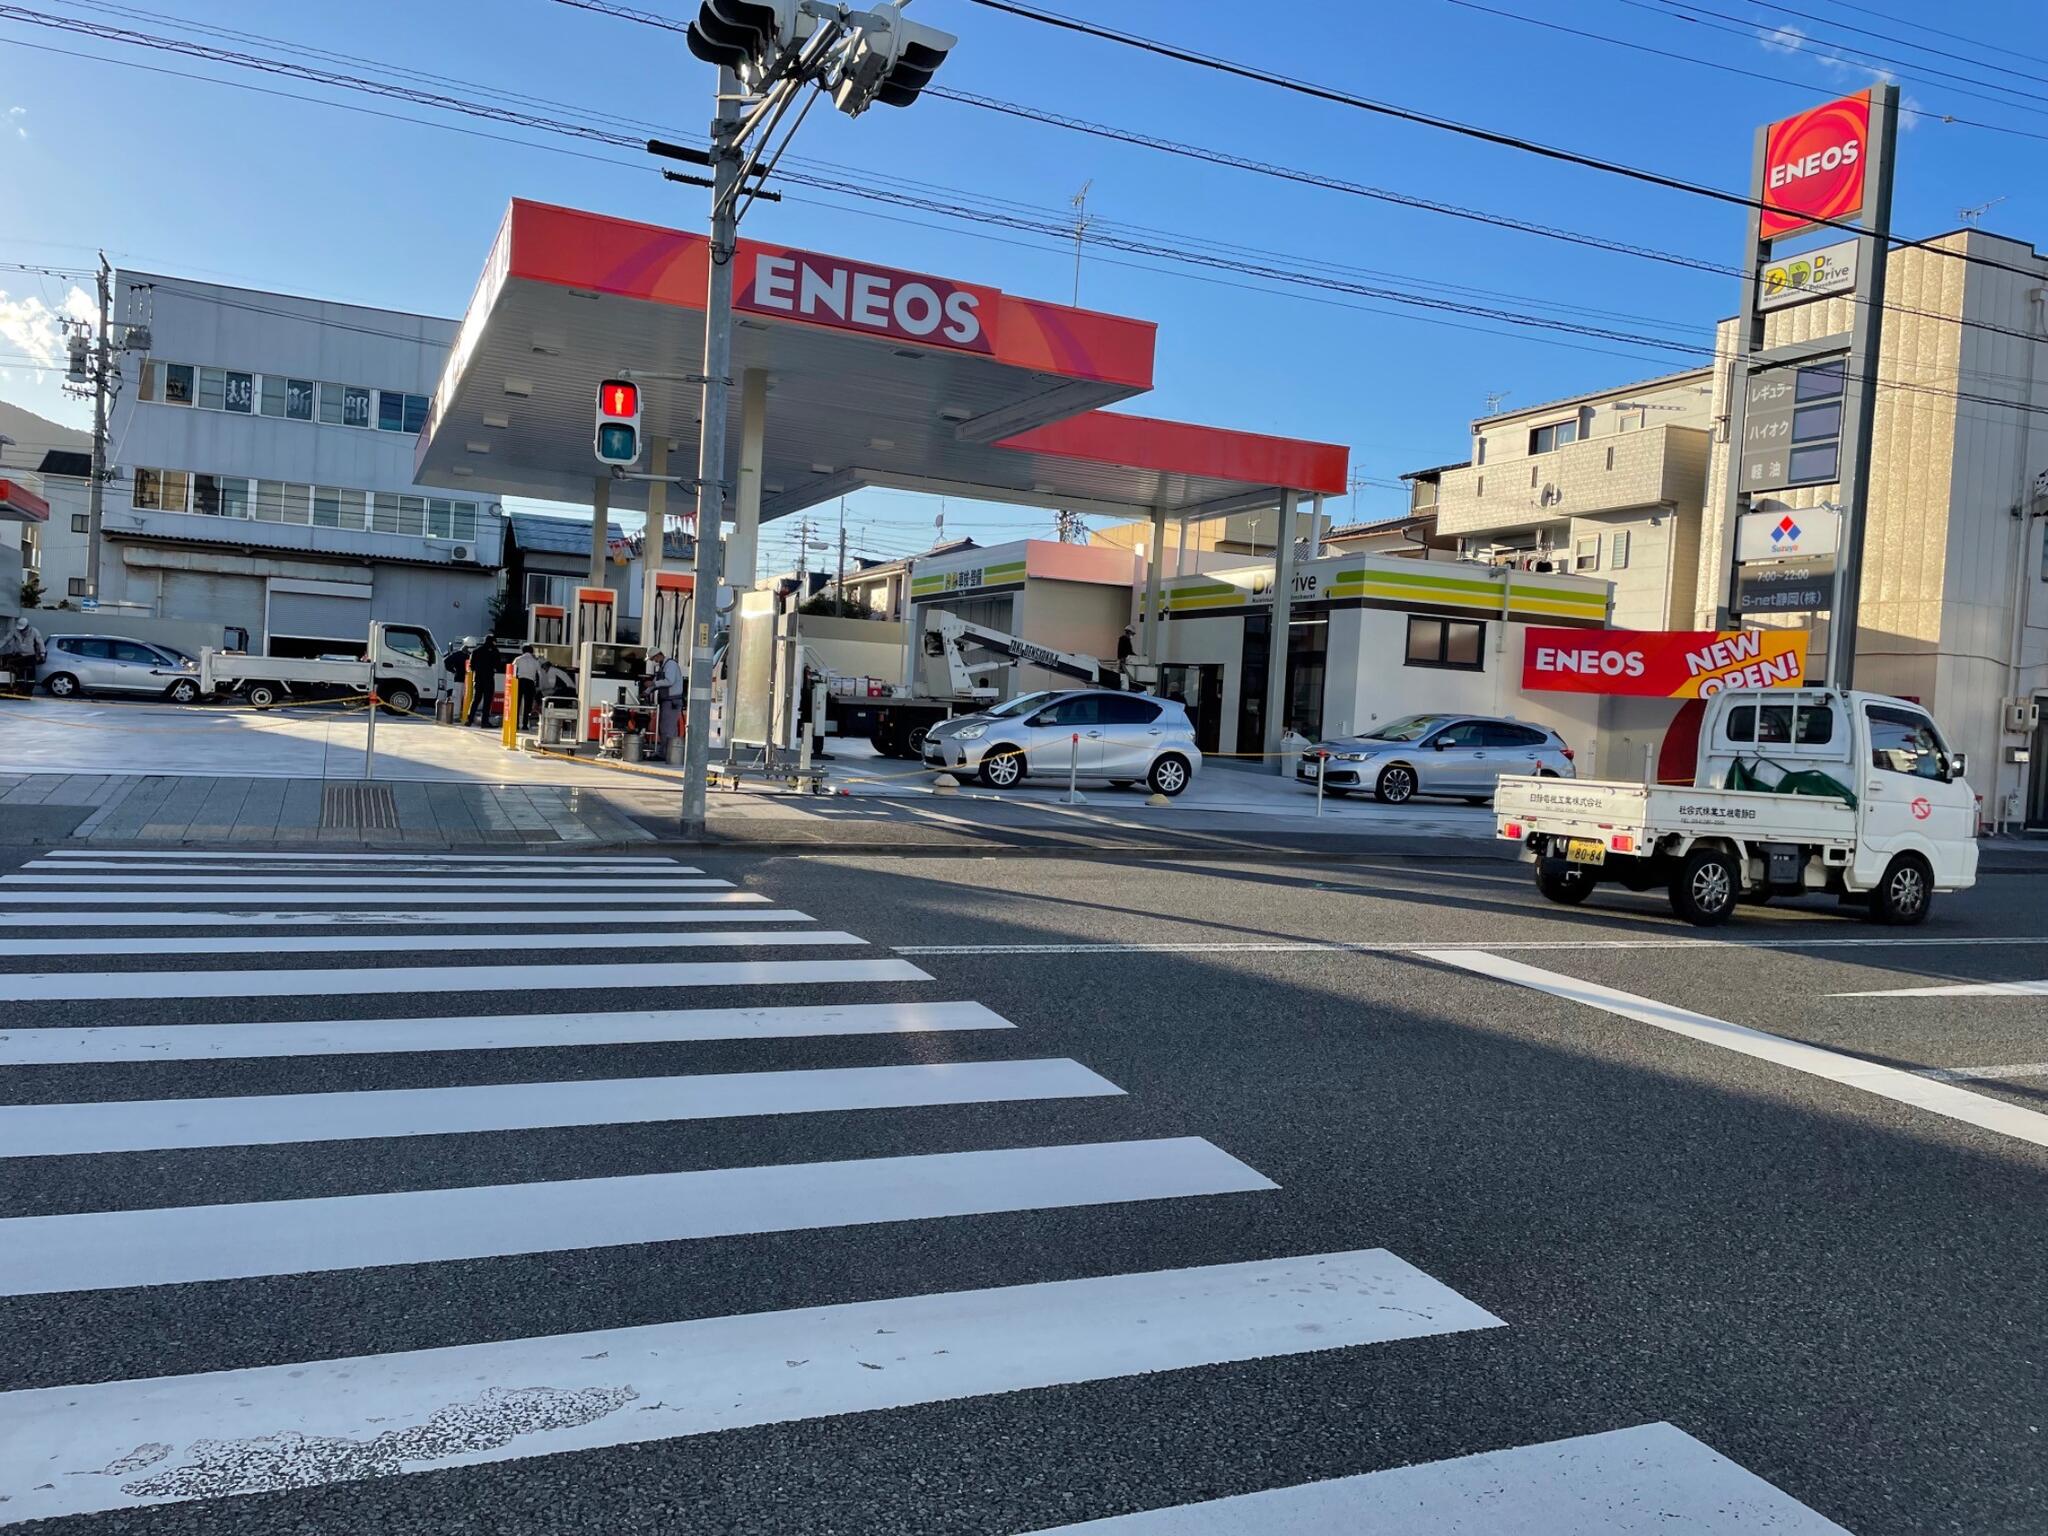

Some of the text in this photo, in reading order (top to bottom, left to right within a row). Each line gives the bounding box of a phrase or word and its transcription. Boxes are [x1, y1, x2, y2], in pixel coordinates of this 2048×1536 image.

[1770, 139, 1859, 189] ENEOS
[1812, 266, 1850, 283] Drive
[1814, 255, 1833, 269] Dr.
[754, 253, 980, 343] ENEOS
[1751, 383, 1793, 403] レギュラー
[1749, 420, 1789, 441] ハイオク
[1536, 647, 1645, 677] ENEOS
[1684, 630, 1761, 678] NEW
